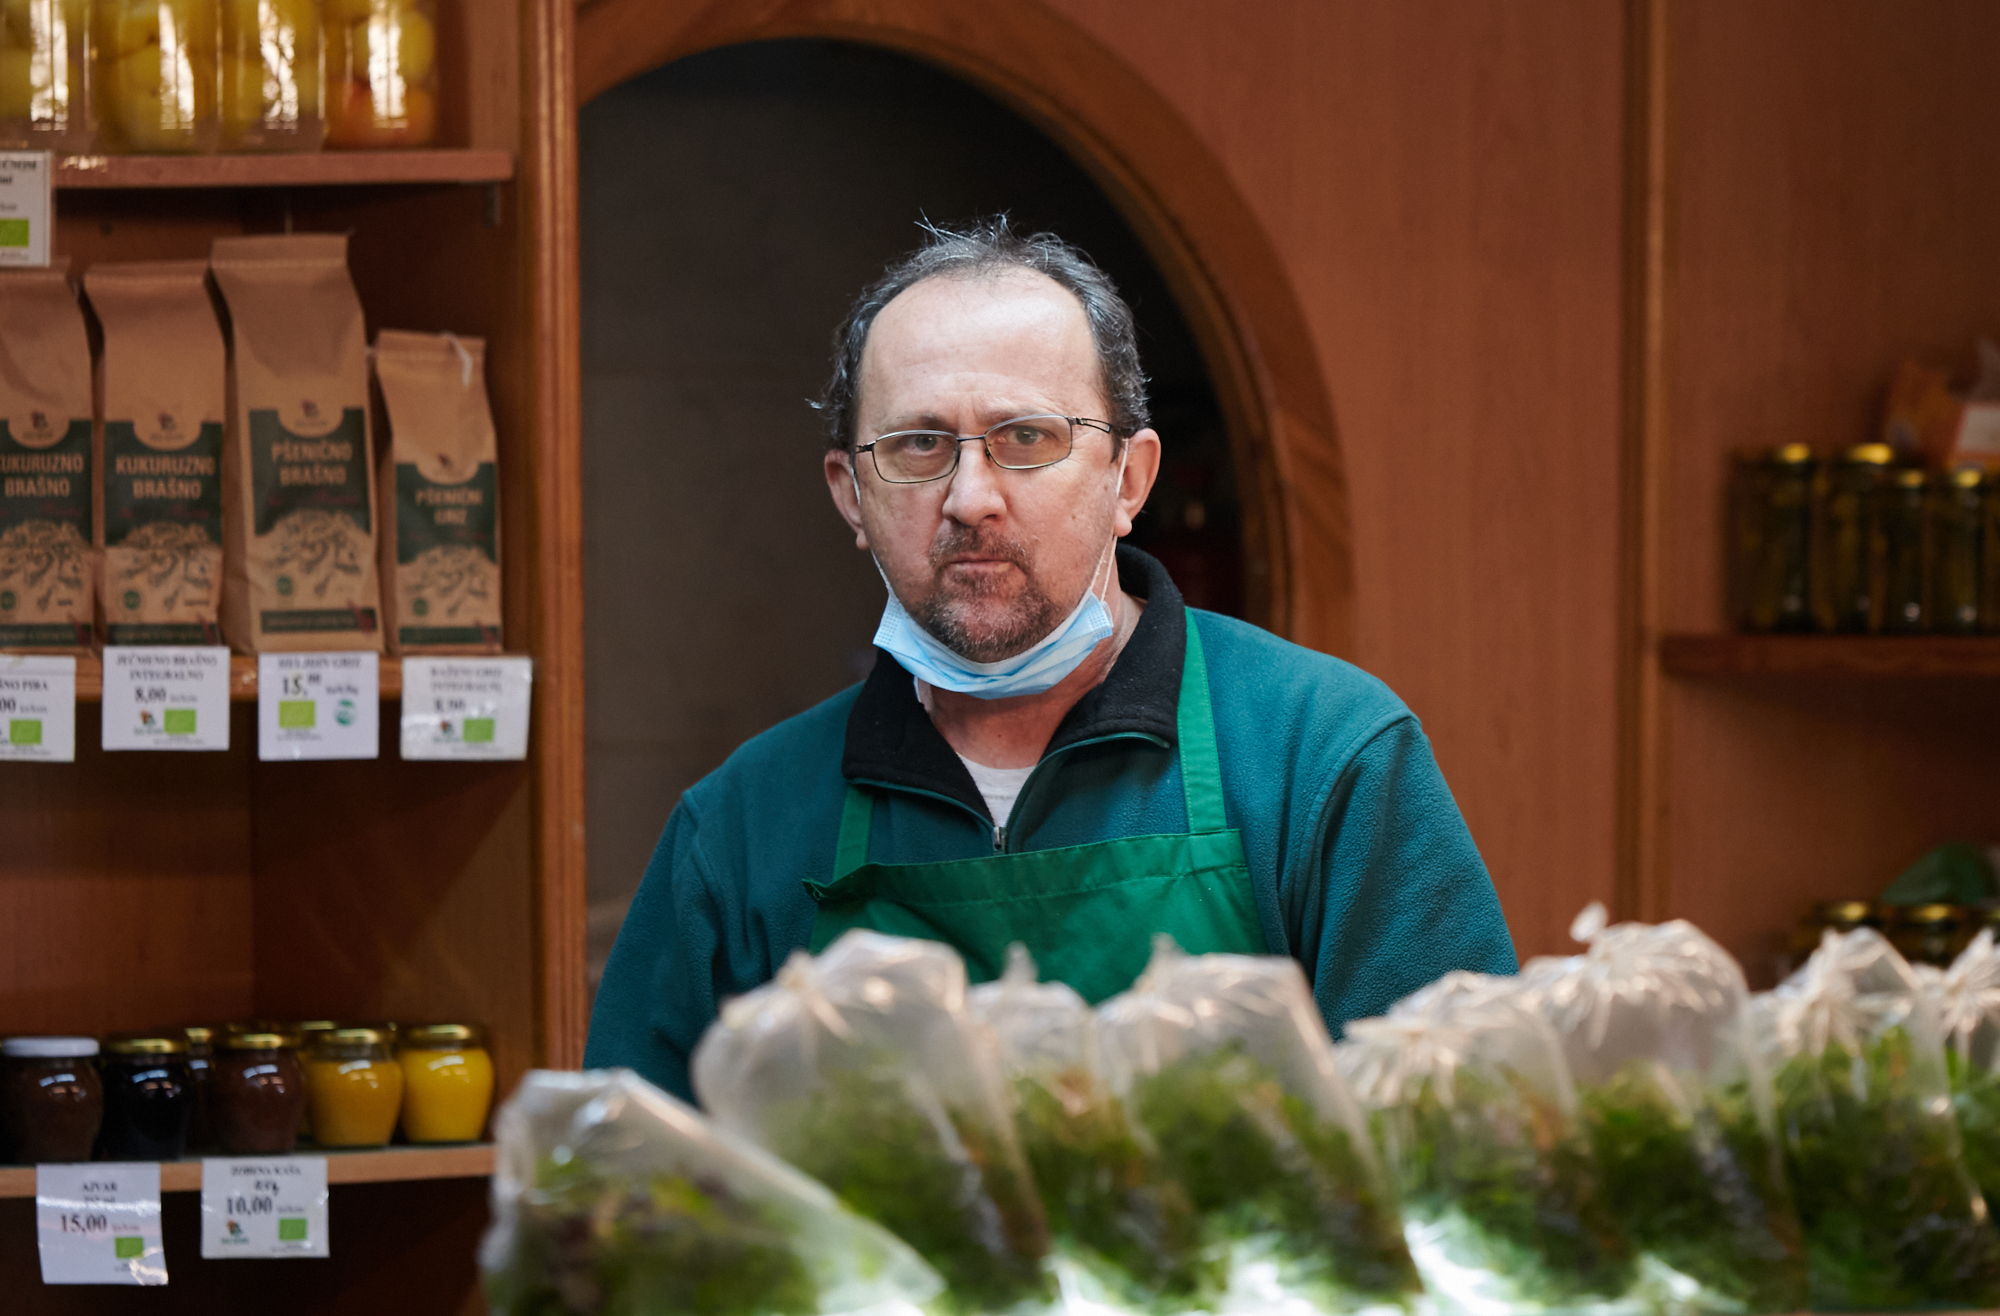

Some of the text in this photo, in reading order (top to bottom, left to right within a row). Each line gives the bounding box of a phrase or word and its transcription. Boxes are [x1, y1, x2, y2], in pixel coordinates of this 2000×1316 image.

[271, 440, 352, 463] PŠENIČNO
[0, 453, 84, 474] UKURUZNO
[115, 455, 216, 476] KUKURUZNO
[280, 463, 347, 487] BRAŠNO
[4, 475, 71, 497] BRAŠNO
[133, 477, 202, 499] BRAŠNO
[135, 687, 166, 703] 8,00
[83, 1182, 118, 1192] AJVAR
[227, 1196, 273, 1215] 10,00
[61, 1213, 107, 1235] 15,00
